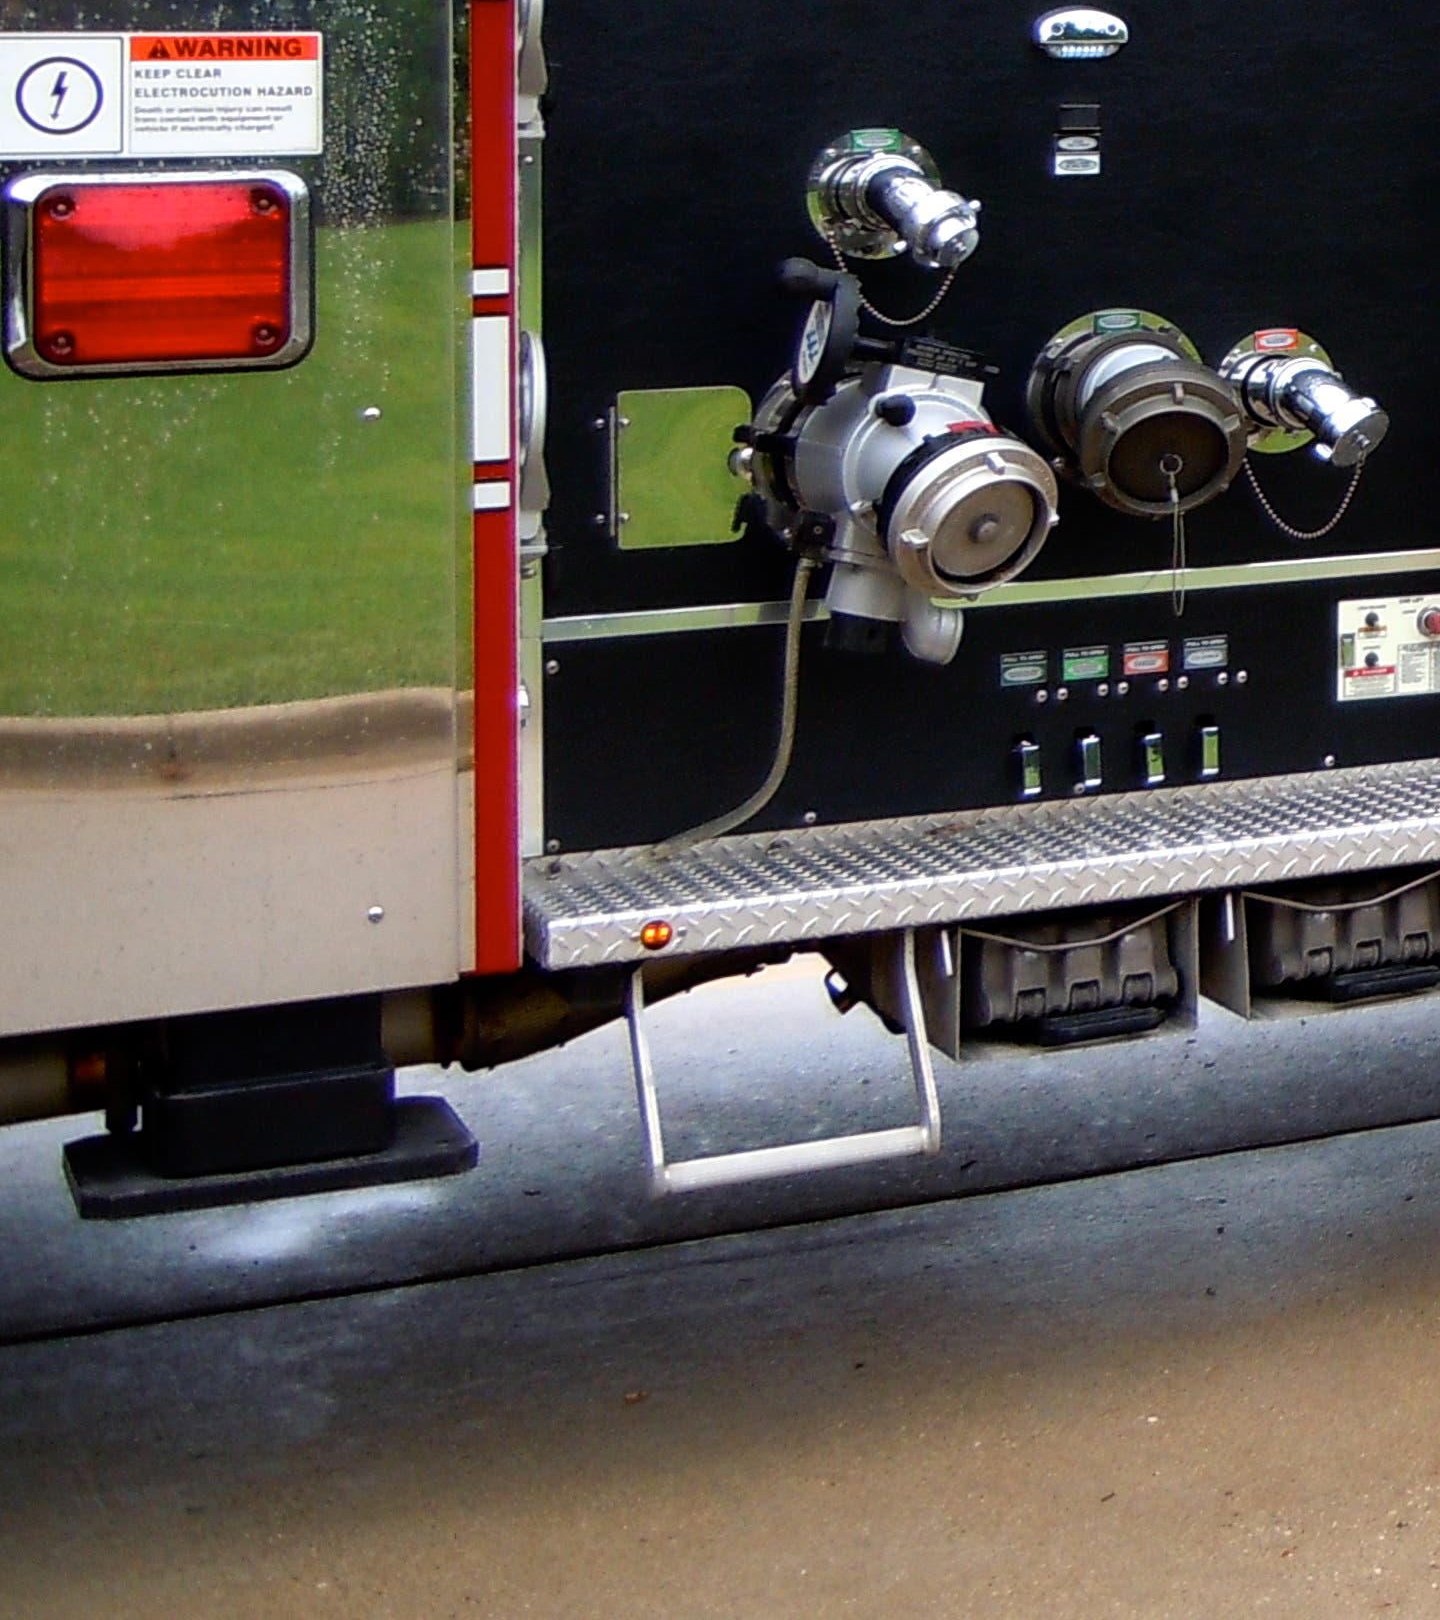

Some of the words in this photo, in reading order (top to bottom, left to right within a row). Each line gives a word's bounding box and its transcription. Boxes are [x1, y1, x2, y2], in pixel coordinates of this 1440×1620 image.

[173, 38, 302, 58] WARNING
[134, 68, 171, 79] KEEP
[175, 68, 222, 79] CLEAR
[134, 87, 252, 98] ELECTROCUTION
[257, 85, 313, 97] HAZARD
